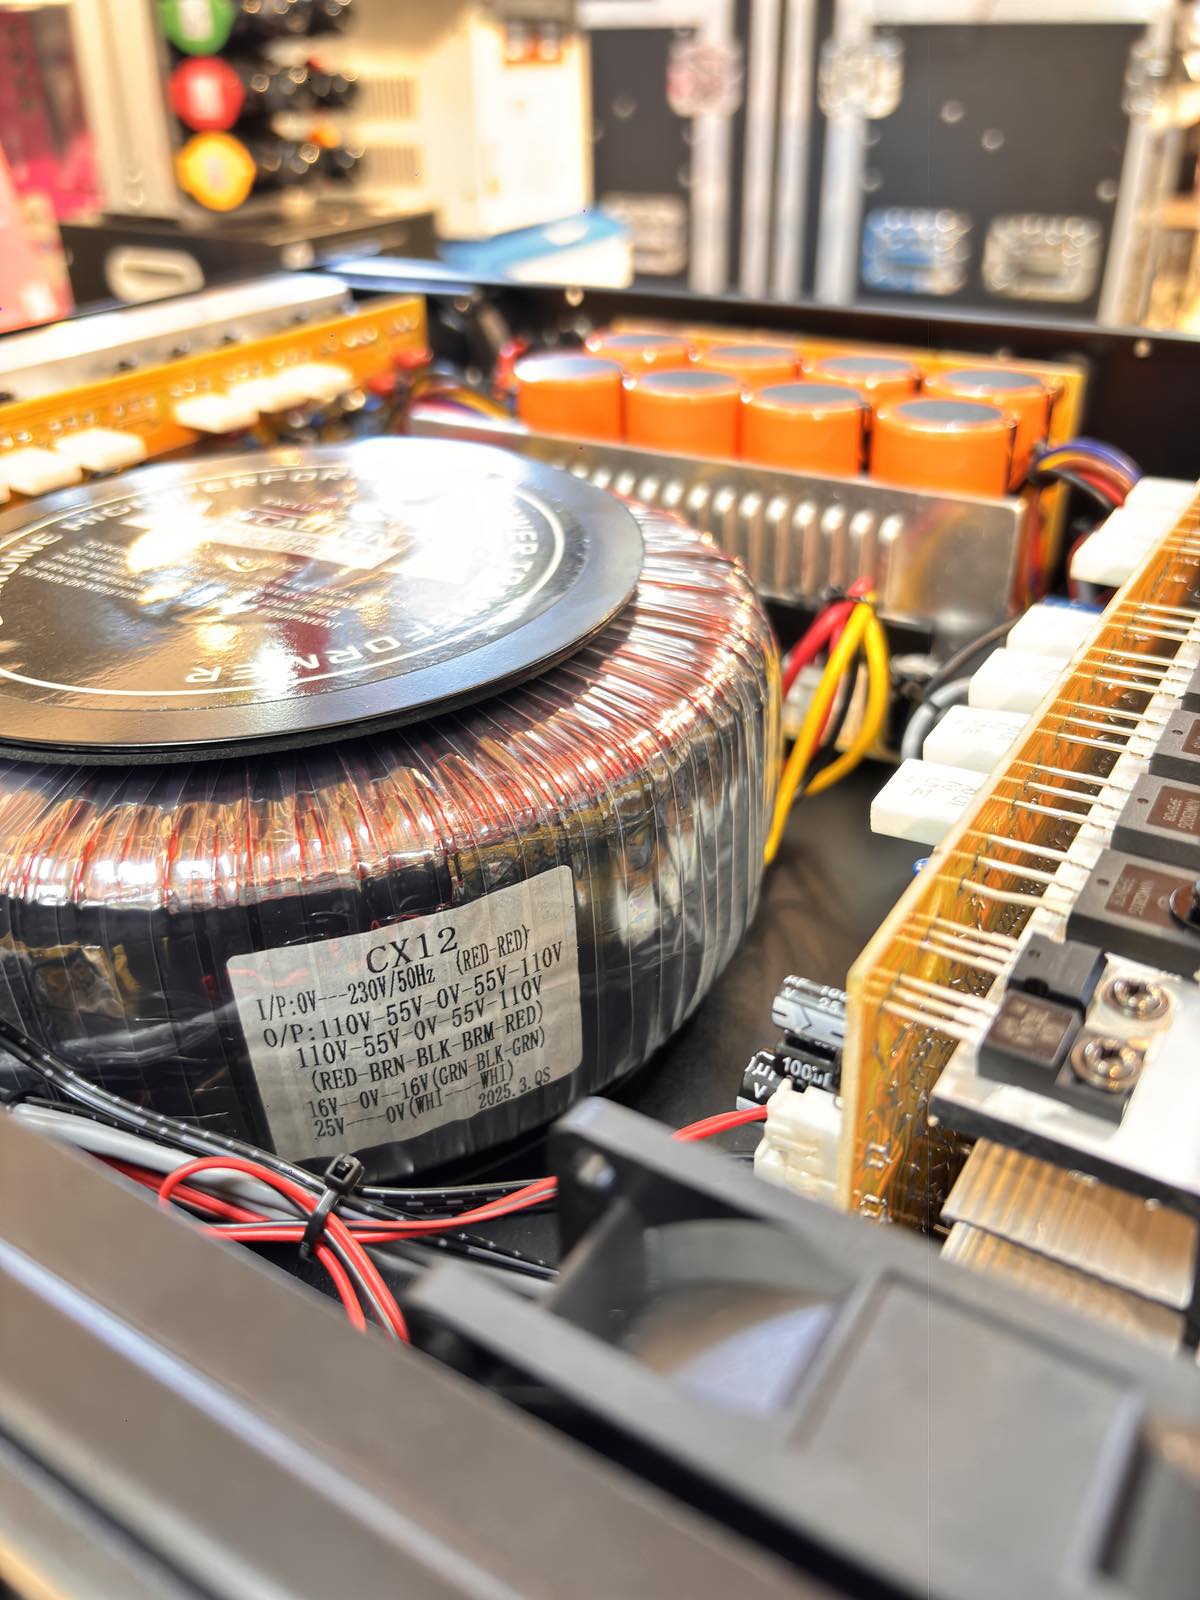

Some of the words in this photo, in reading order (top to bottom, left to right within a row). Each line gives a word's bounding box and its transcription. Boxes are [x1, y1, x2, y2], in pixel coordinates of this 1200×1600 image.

[366, 926, 458, 974] CX12
[456, 923, 529, 975] (RED-RED)
[297, 975, 543, 1068] 110V-55V-0V-55V-110V
[312, 1000, 543, 1093] (RED-BRN-BLK-BRM-RED)
